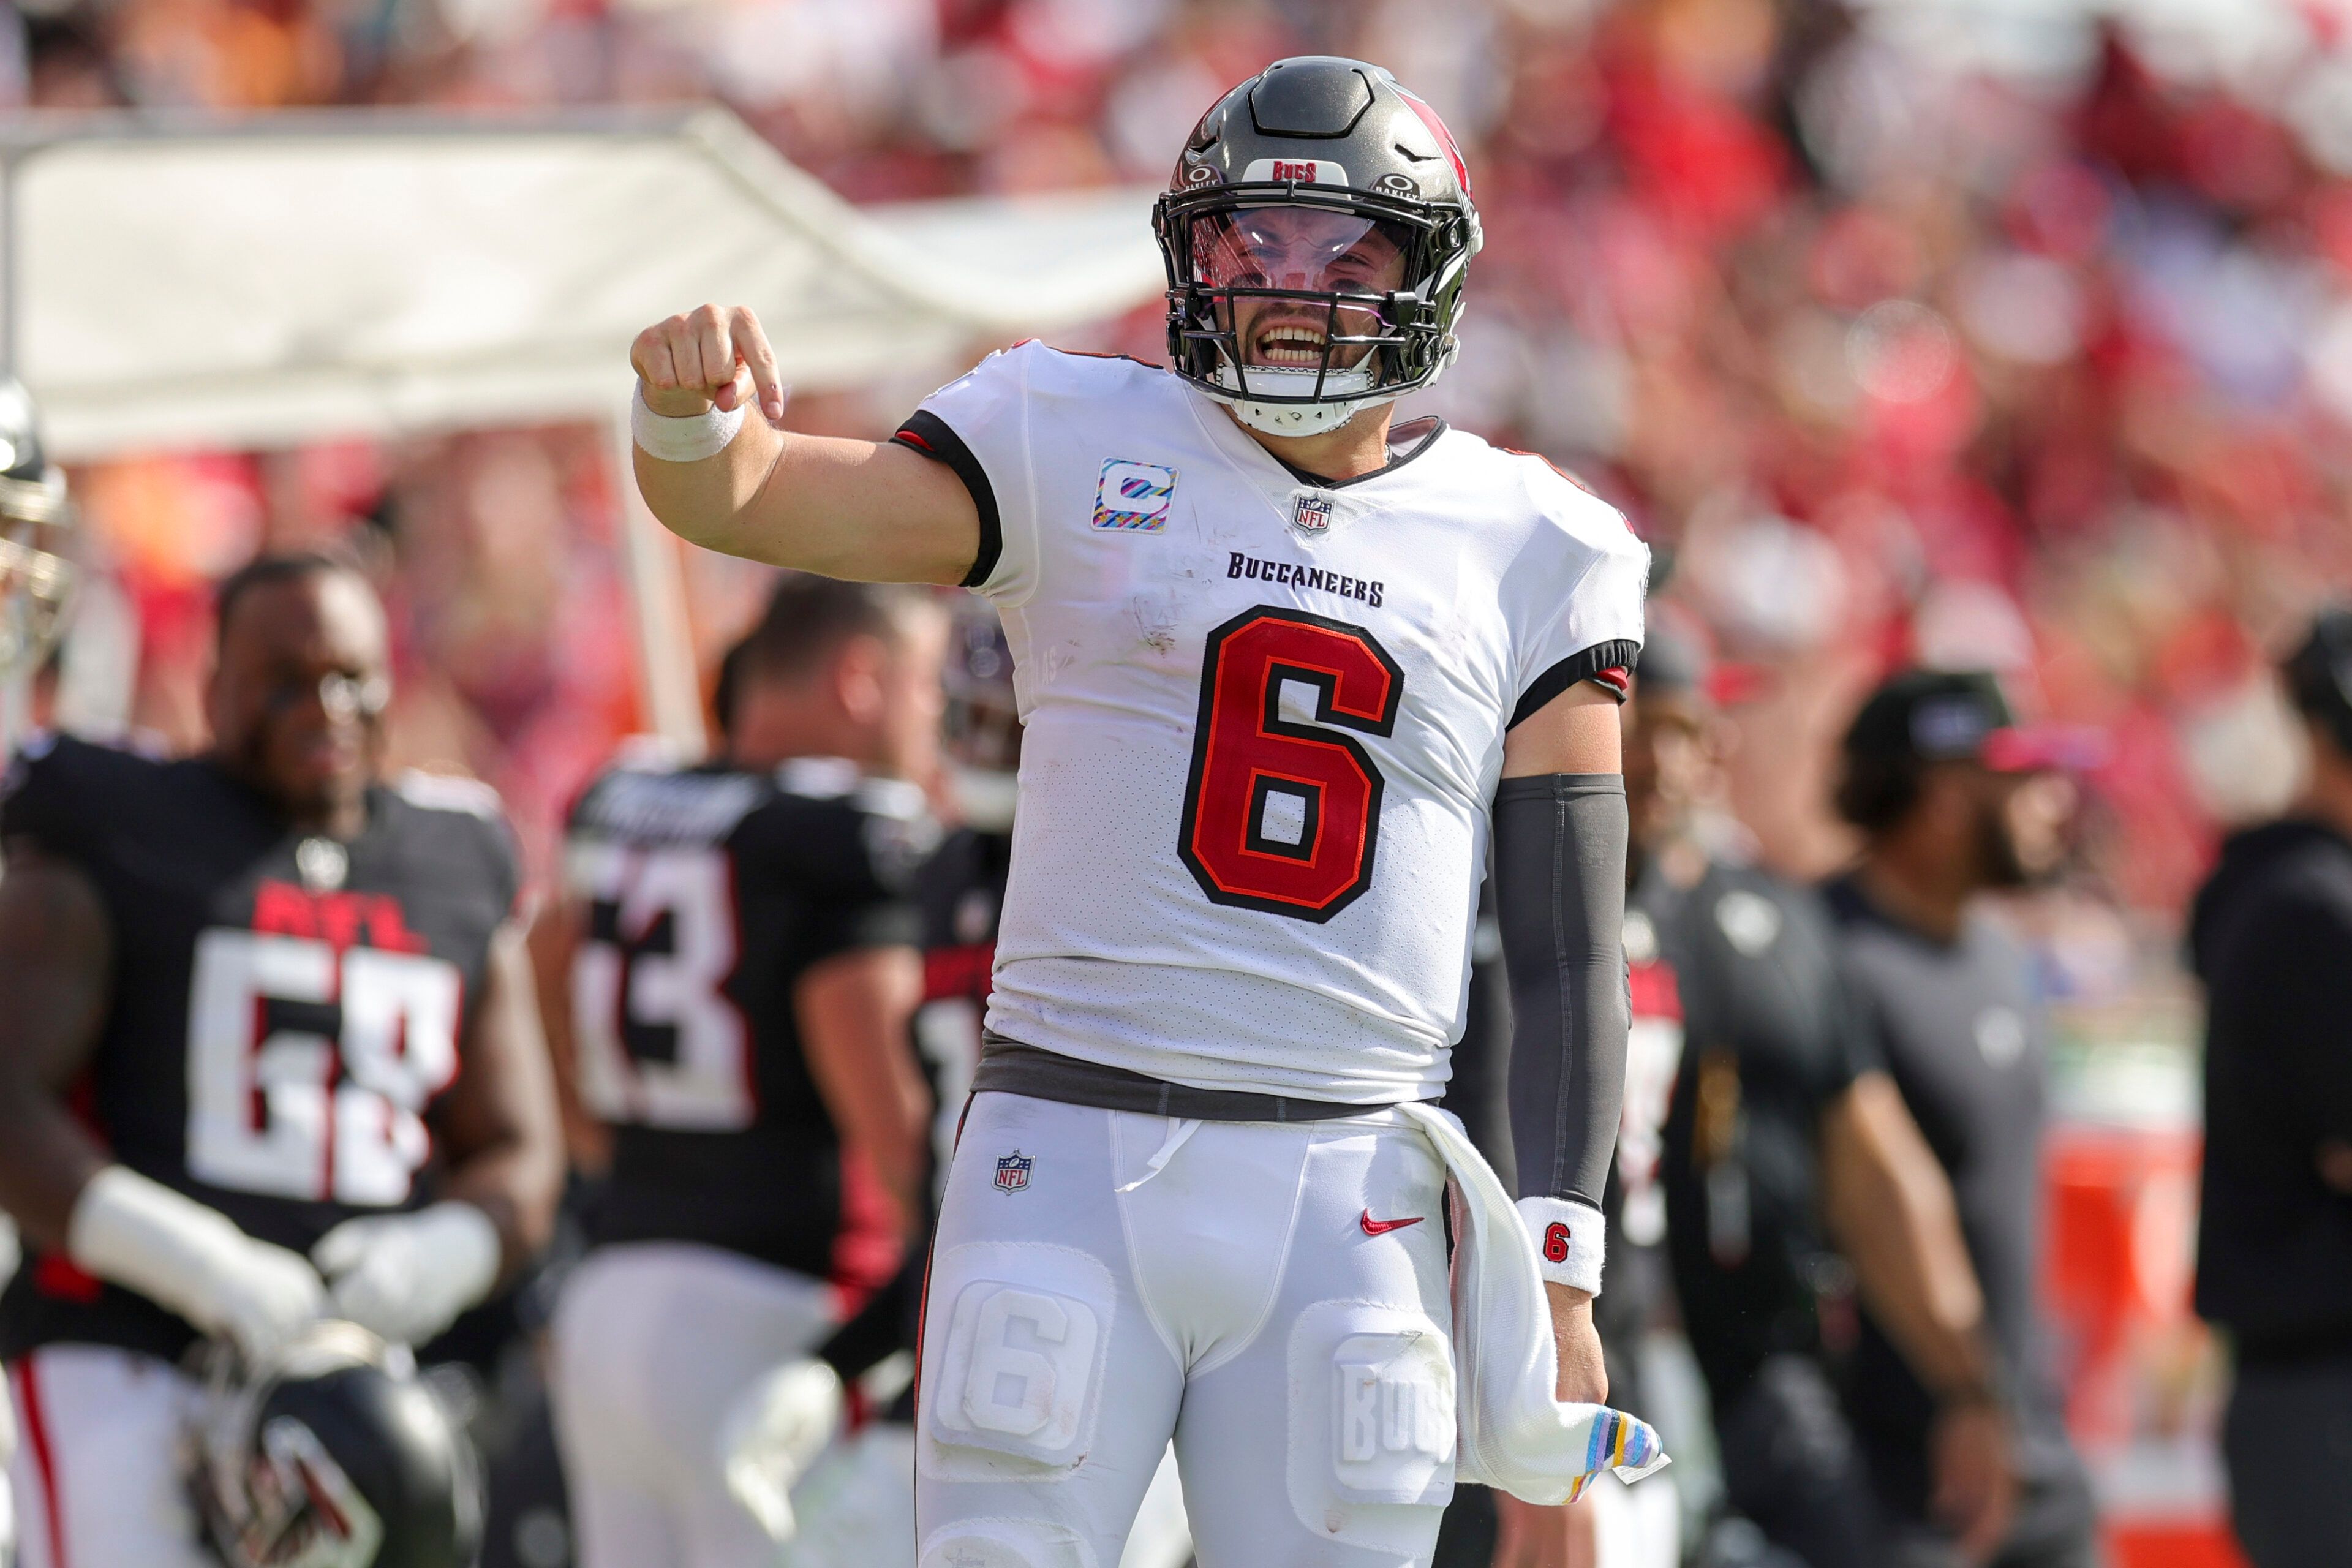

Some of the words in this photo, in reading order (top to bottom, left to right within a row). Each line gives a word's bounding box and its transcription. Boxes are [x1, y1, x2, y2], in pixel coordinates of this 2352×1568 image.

[1273, 161, 1316, 183] BUCS
[1101, 462, 1171, 514] C
[1298, 509, 1325, 527] NFL
[1227, 551, 1384, 608] BUCCANEERS
[1177, 604, 1405, 925] 6
[186, 924, 464, 1207] 68
[998, 1169, 1025, 1187] NFL
[1543, 1221, 1570, 1264] 6
[963, 1289, 1068, 1436] 6
[1339, 1365, 1455, 1463] BUC
